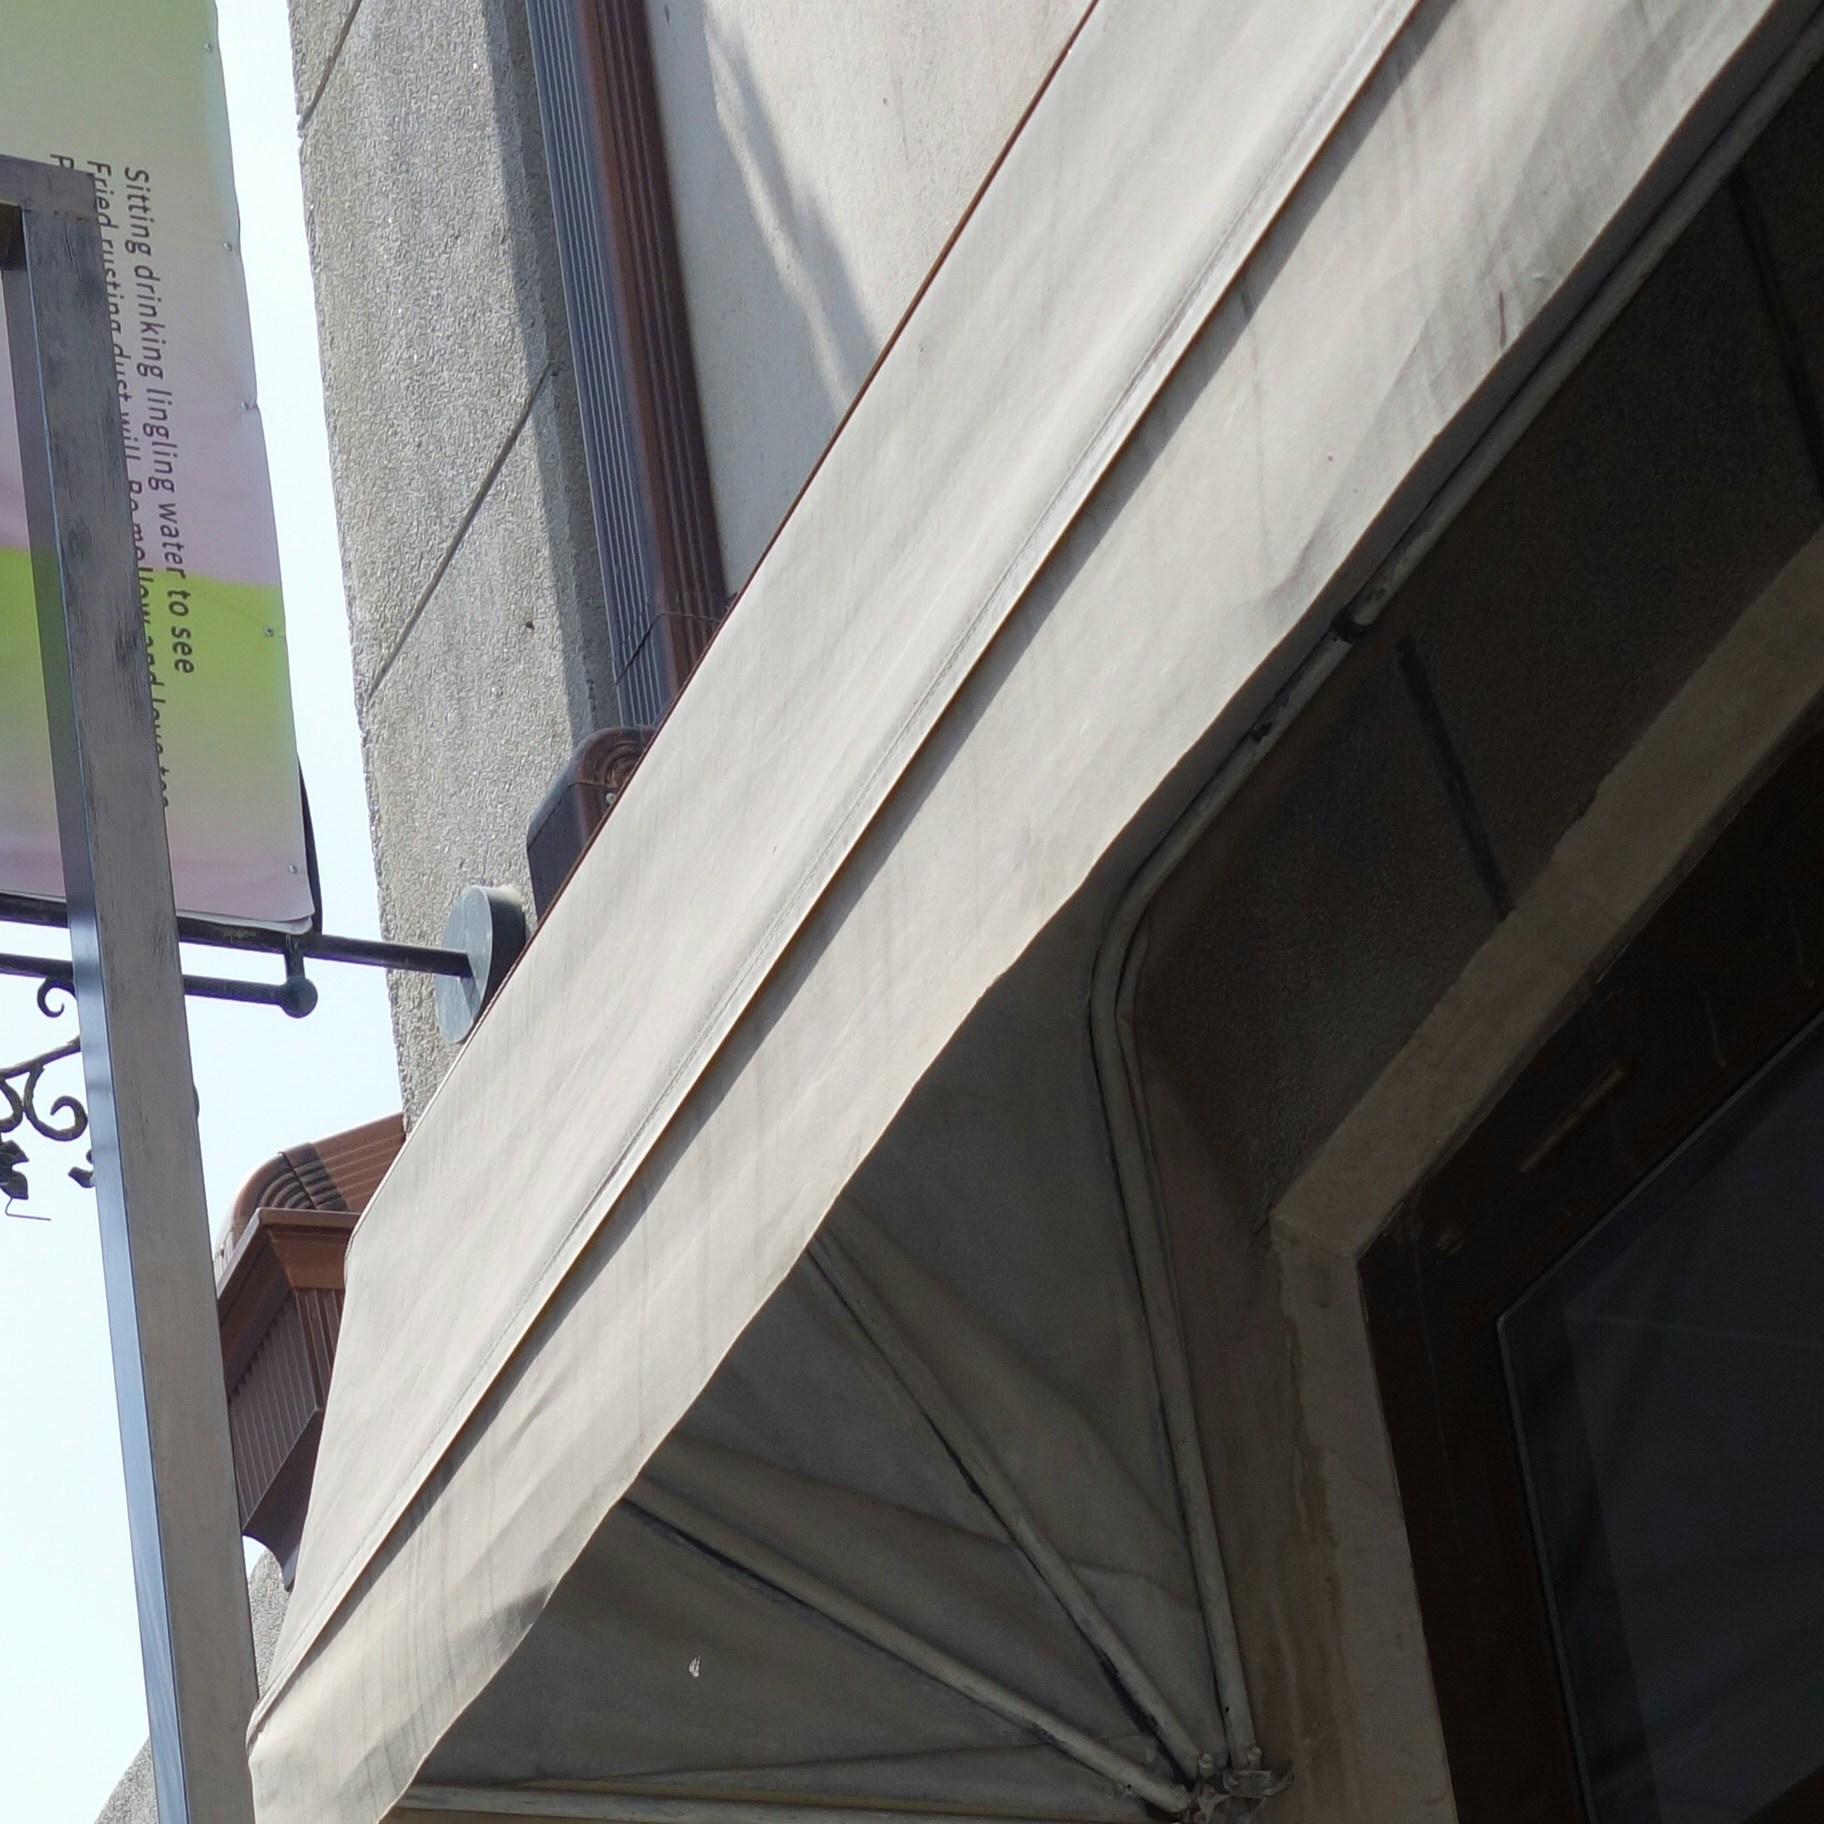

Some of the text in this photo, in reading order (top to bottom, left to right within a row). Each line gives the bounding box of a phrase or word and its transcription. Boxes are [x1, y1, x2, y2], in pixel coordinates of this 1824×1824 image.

[124, 166, 152, 258] Sitting
[134, 264, 166, 380] drinking
[141, 388, 178, 494] lingling
[158, 502, 187, 579] water
[166, 589, 190, 617] to
[171, 626, 195, 674] see
